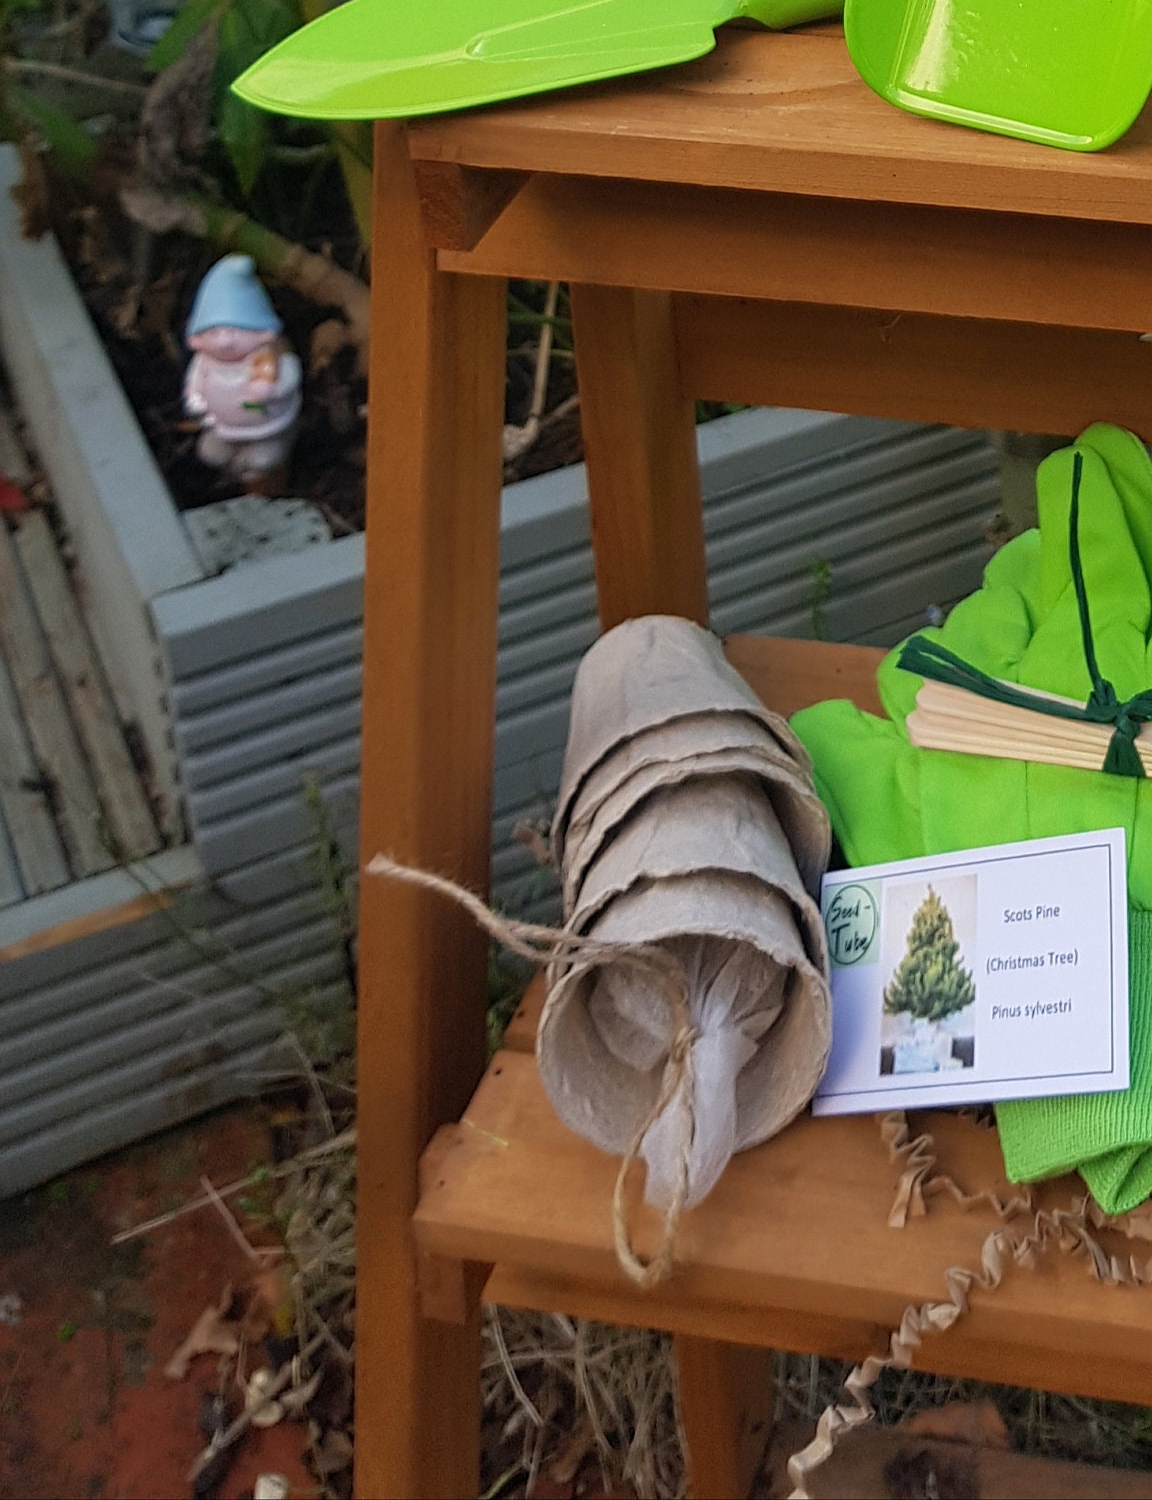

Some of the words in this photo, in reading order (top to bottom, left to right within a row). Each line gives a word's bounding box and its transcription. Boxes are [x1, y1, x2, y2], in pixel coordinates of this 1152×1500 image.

[1004, 908, 1033, 924] Scots
[1036, 905, 1061, 919] Pine
[831, 924, 868, 954] Tube
[986, 955, 1045, 975] (Christmas
[1048, 949, 1079, 967] Tree)
[992, 1004, 1022, 1020] Pinus
[1025, 998, 1072, 1019] sylvestri
